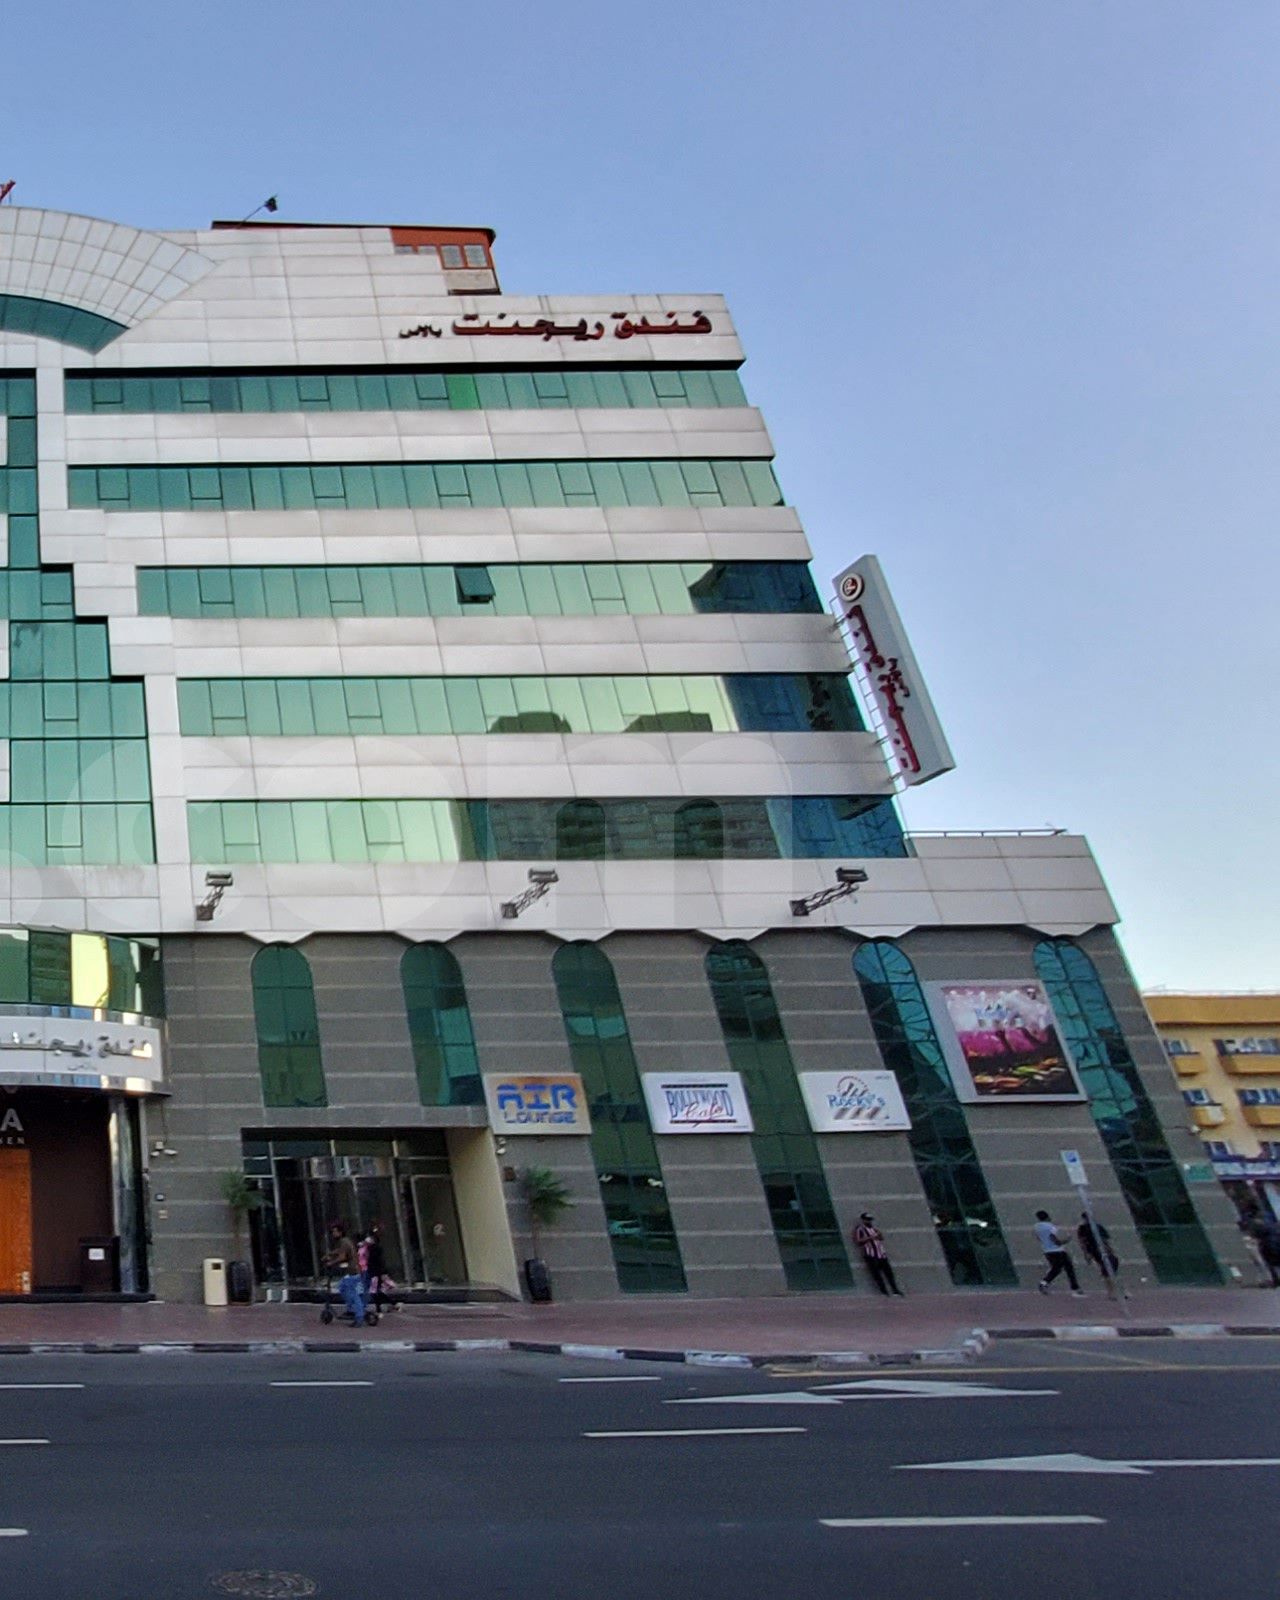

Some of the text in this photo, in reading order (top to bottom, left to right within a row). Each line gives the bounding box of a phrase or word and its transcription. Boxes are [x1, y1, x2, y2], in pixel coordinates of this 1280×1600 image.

[452, 312, 605, 341] ريجنت
[612, 309, 713, 339] فندق
[98, 1035, 153, 1059] فندق
